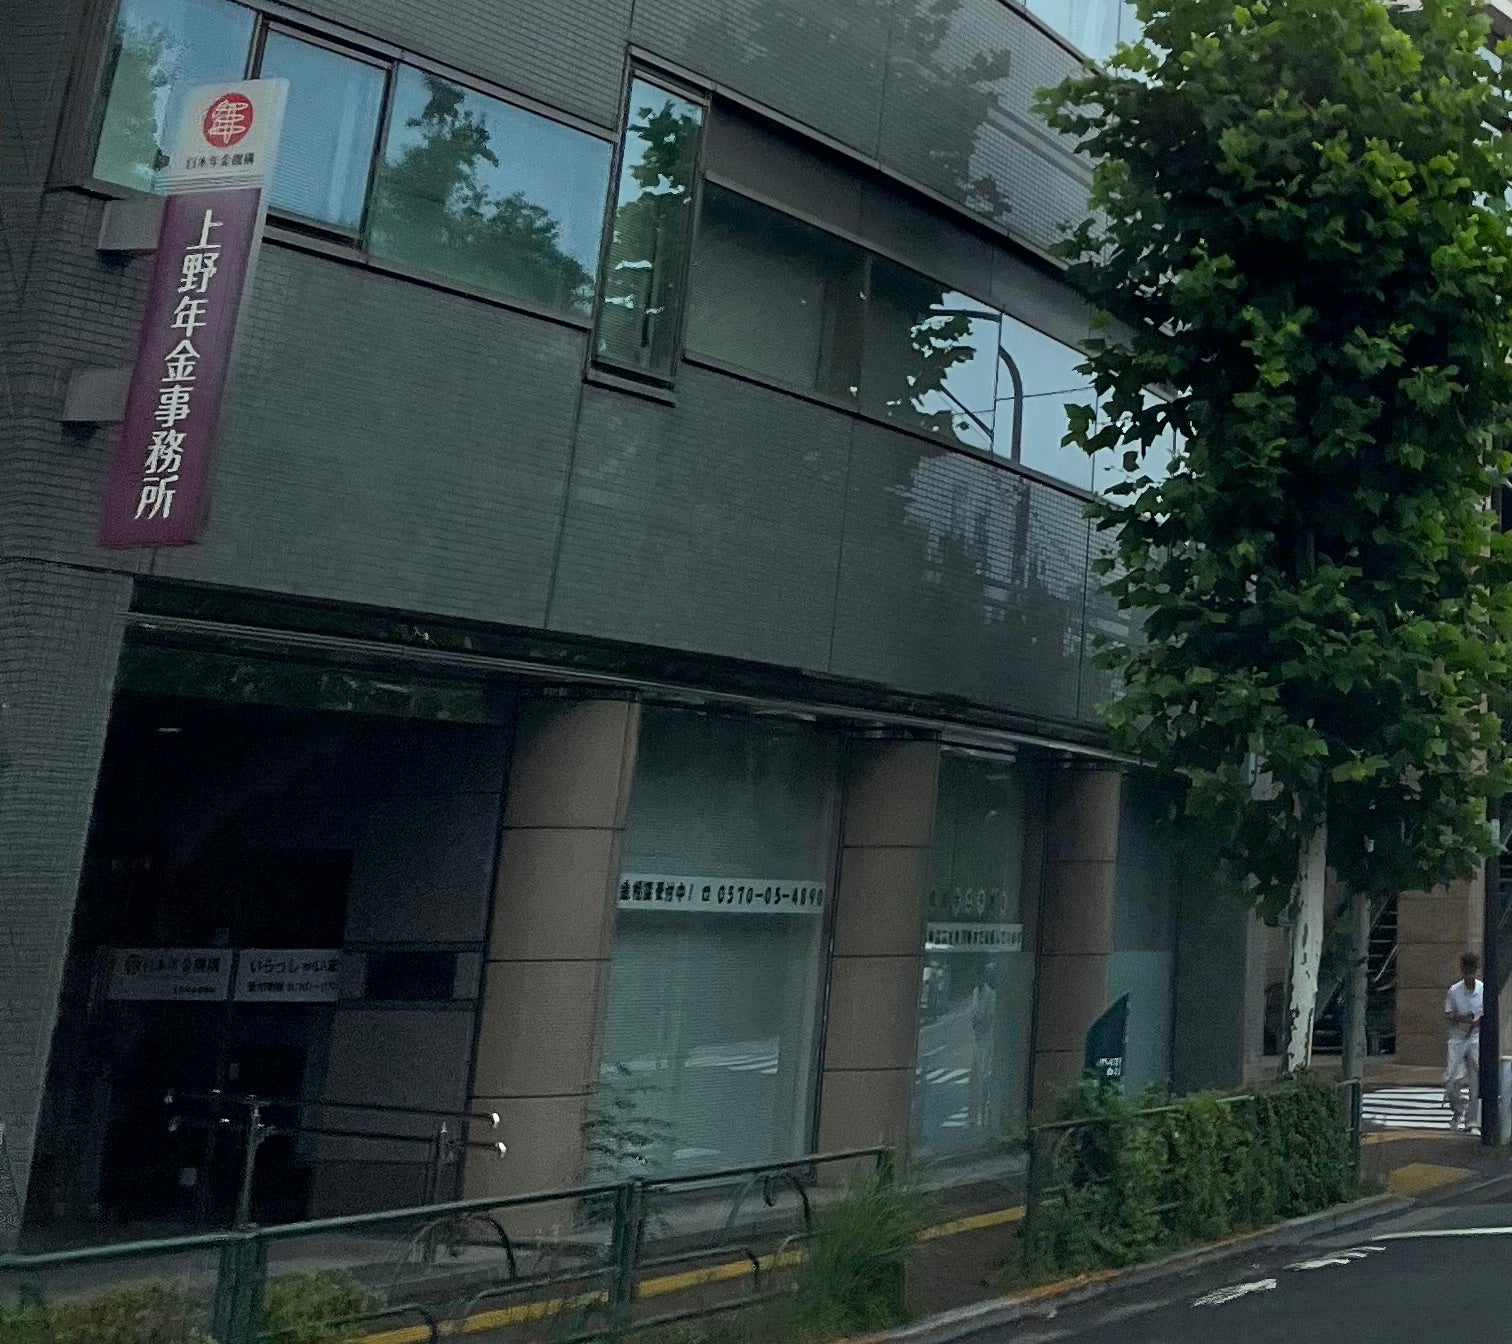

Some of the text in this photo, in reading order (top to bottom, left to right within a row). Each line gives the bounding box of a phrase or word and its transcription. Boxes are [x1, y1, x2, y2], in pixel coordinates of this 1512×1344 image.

[133, 209, 224, 520] 上野年金事務所
